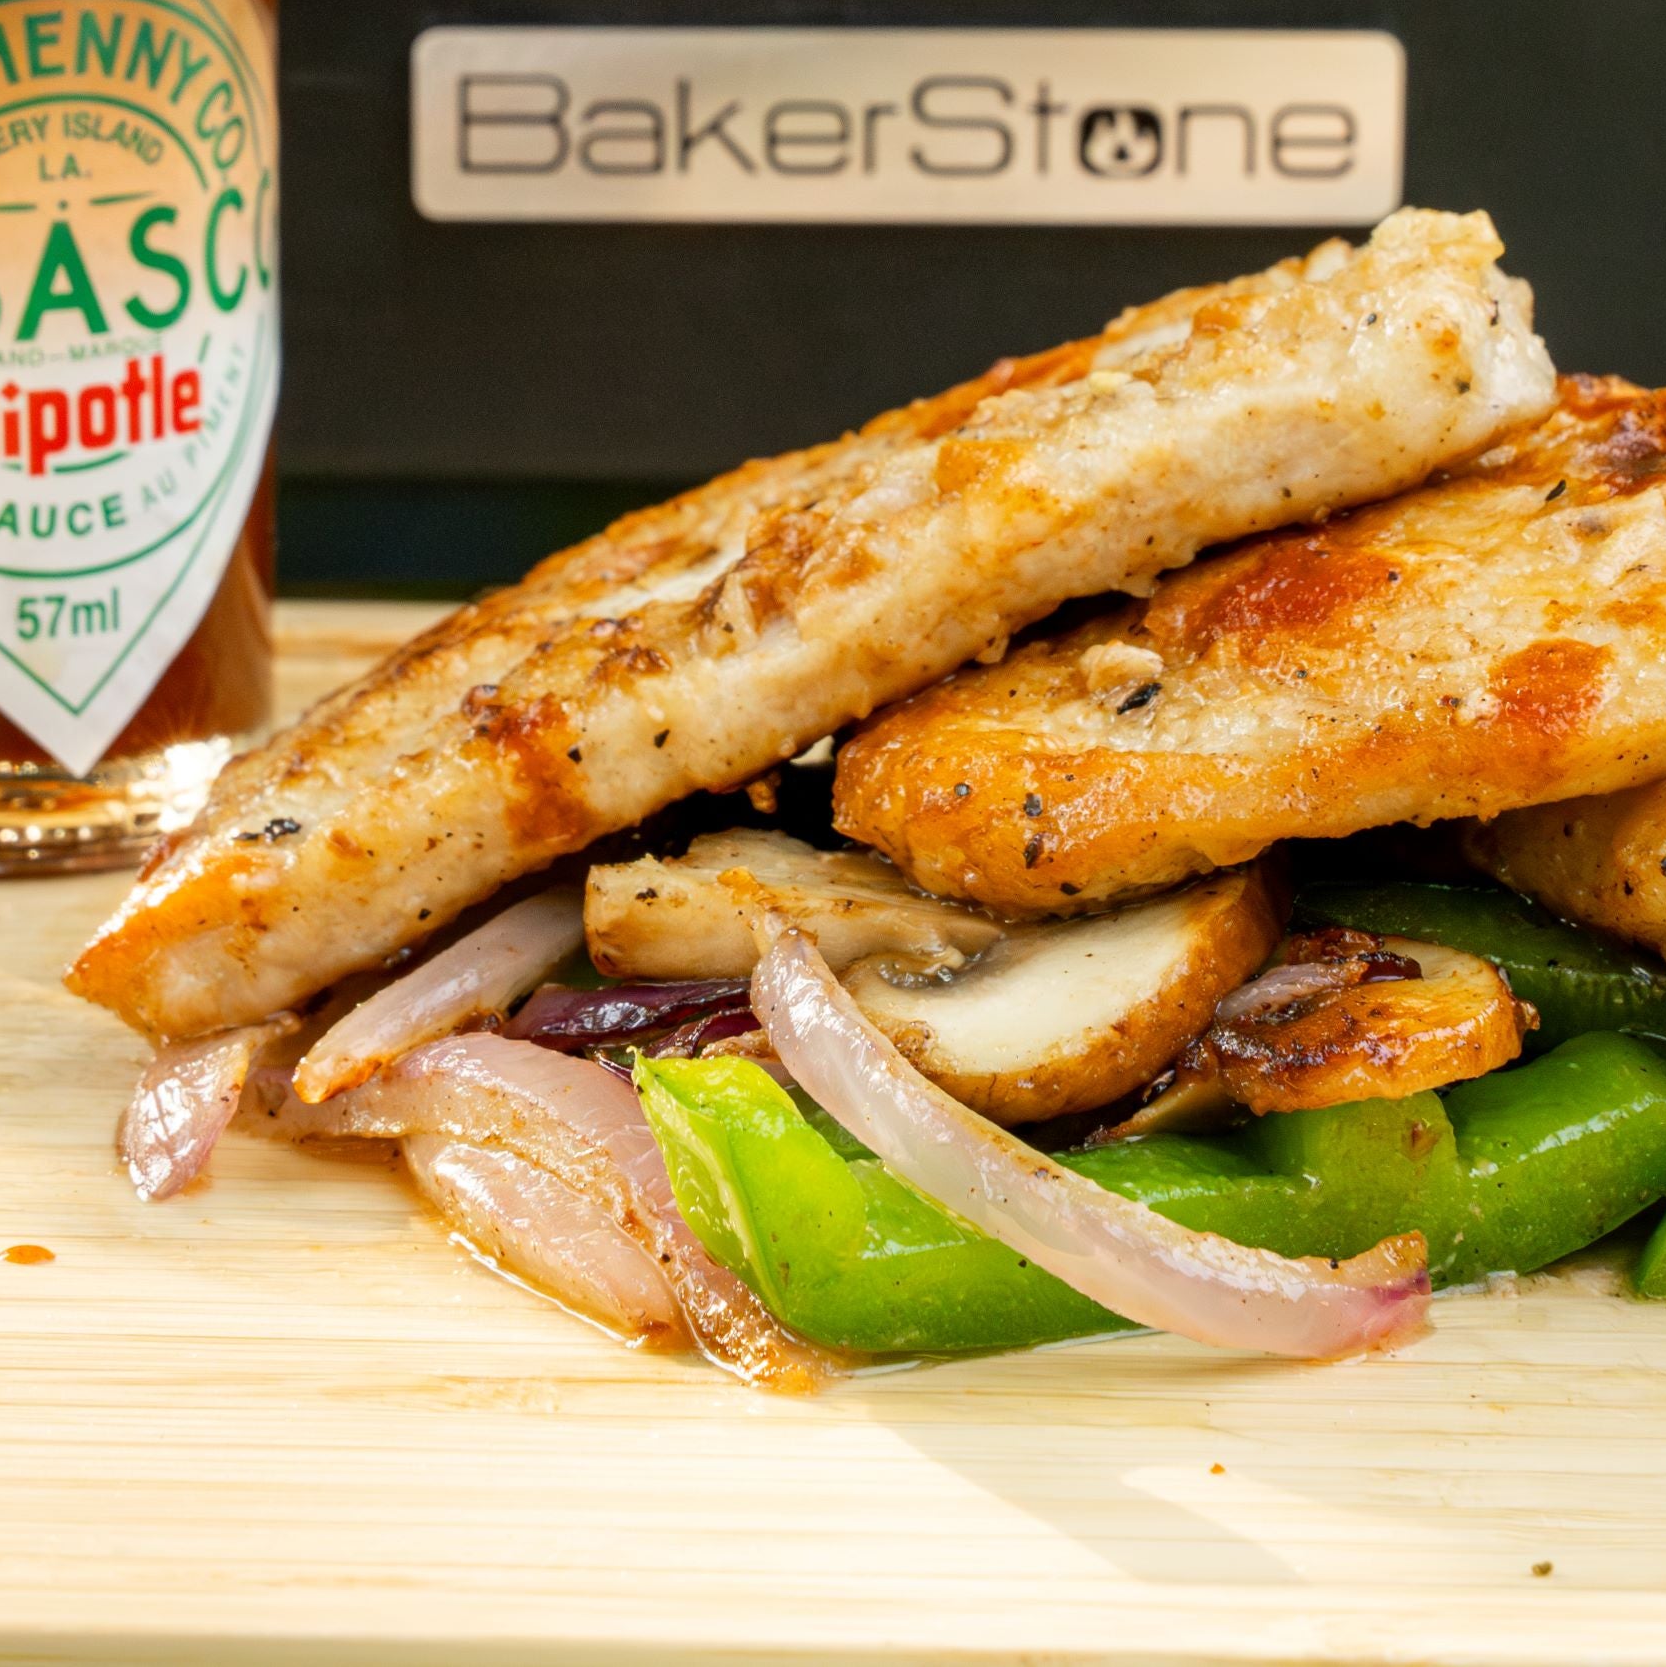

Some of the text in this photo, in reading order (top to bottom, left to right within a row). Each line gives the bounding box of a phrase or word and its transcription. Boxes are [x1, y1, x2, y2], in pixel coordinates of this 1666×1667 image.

[62, 111, 165, 165] ISLAND
[456, 71, 1360, 180] BakerStone
[16, 588, 121, 641] 57ml
